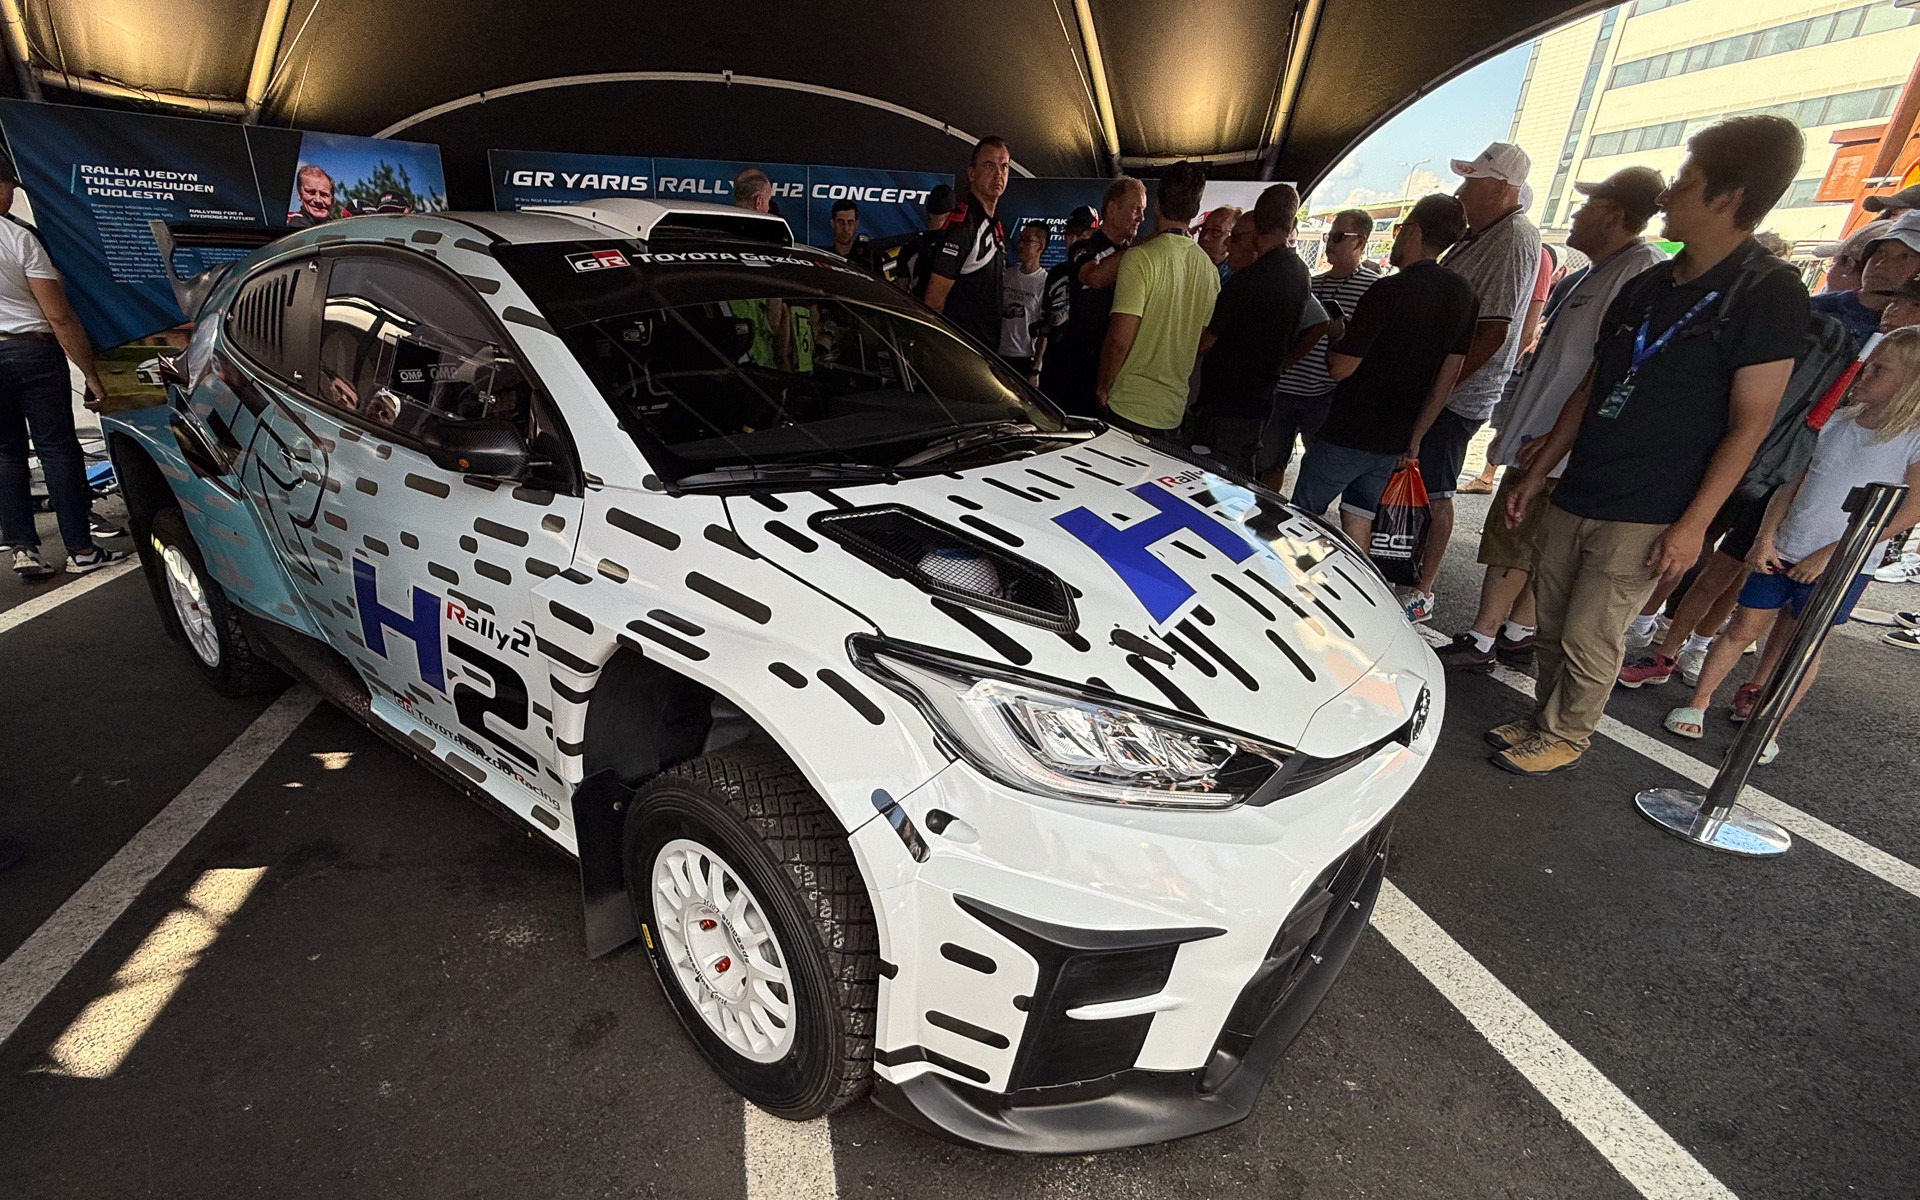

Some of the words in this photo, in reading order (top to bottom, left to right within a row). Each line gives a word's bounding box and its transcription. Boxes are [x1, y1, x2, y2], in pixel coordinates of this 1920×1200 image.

[80, 164, 140, 177] RALLIA
[144, 169, 198, 182] VEDYN
[82, 175, 214, 193] TULEVAISUUDEN
[512, 171, 555, 187] GR
[561, 173, 648, 191] YARIS
[811, 184, 930, 204] CONCEPT
[87, 187, 174, 201] PUOLESTA
[573, 256, 625, 271] GR
[632, 252, 737, 264] TOYOTA
[446, 601, 531, 657] Rally2
[511, 772, 561, 811] Racing
